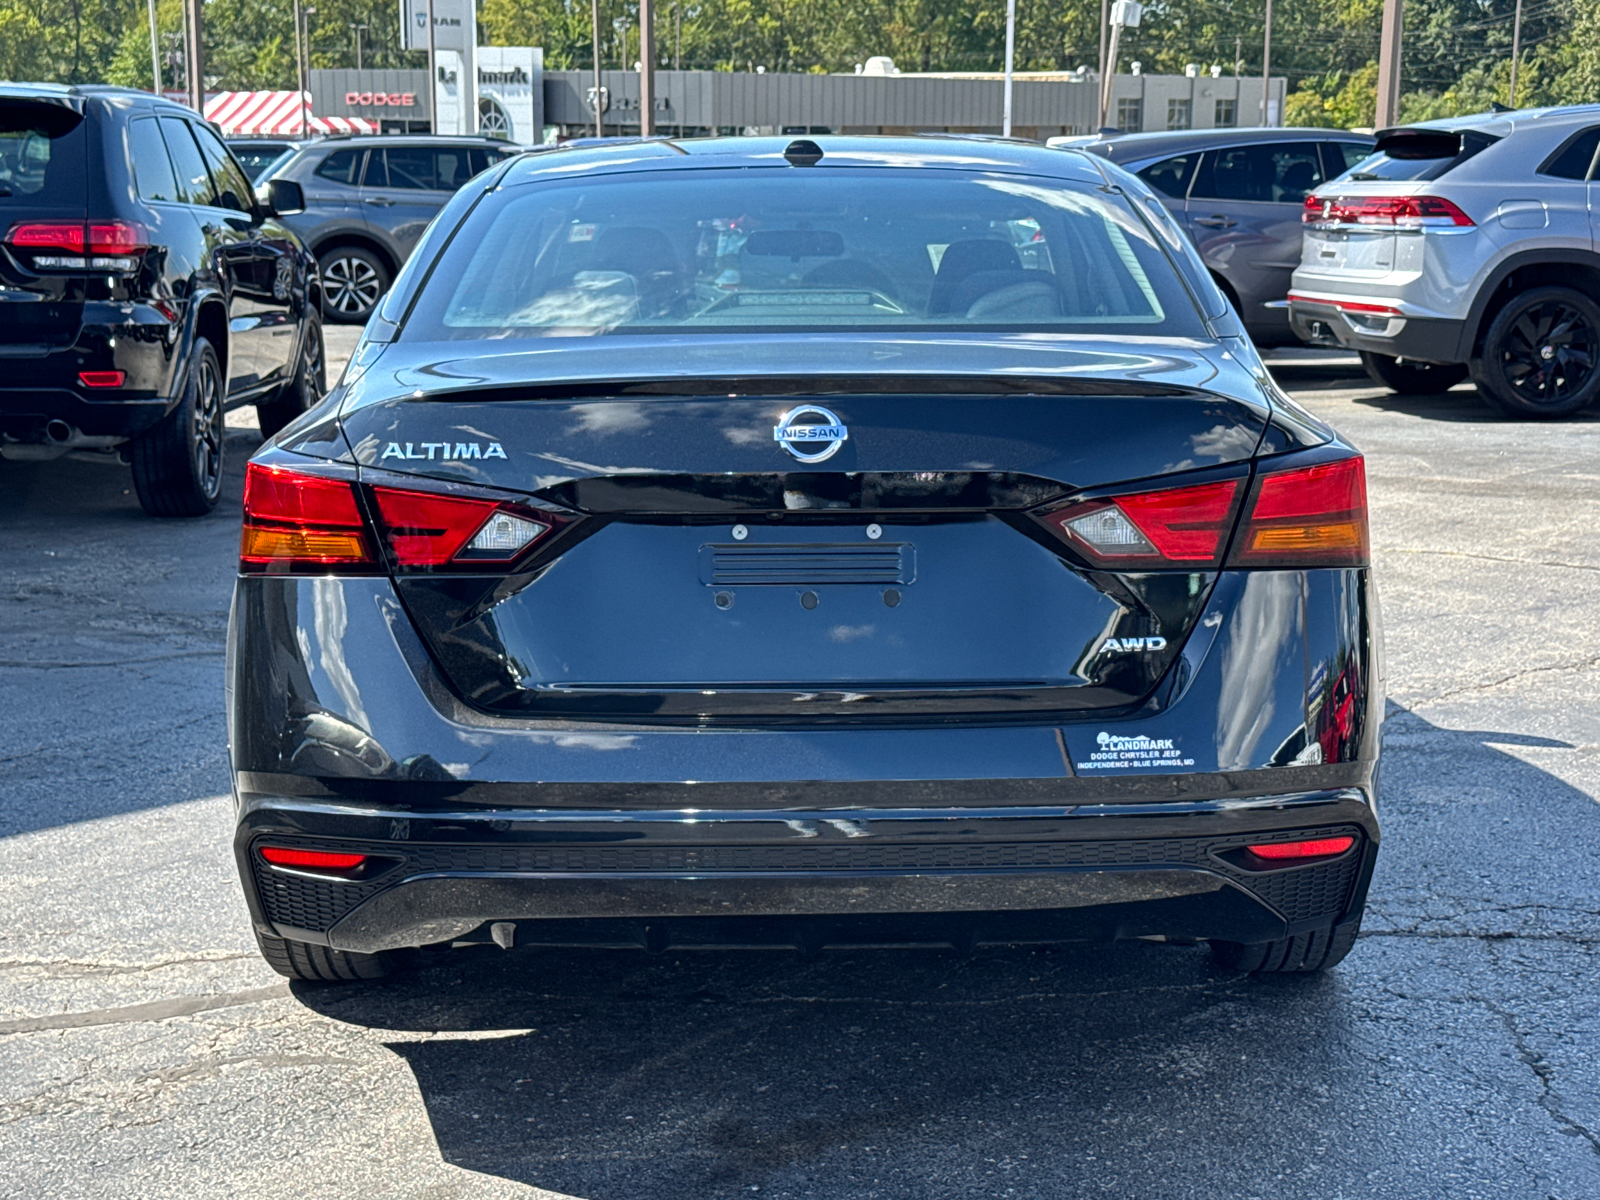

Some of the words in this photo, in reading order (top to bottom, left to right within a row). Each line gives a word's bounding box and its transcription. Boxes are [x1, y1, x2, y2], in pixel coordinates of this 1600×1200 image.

[438, 65, 528, 85] Lamark
[345, 92, 414, 106] DODGE
[781, 427, 840, 439] NISSAN
[381, 441, 508, 460] ALTIMA
[1099, 636, 1167, 653] AWD
[1110, 740, 1173, 751] LANDMARK
[1091, 752, 1118, 760] DODGE
[1120, 751, 1160, 759] CHRYSLER
[1162, 750, 1181, 758] JEEP
[1078, 761, 1129, 769] INDEPENDENCE
